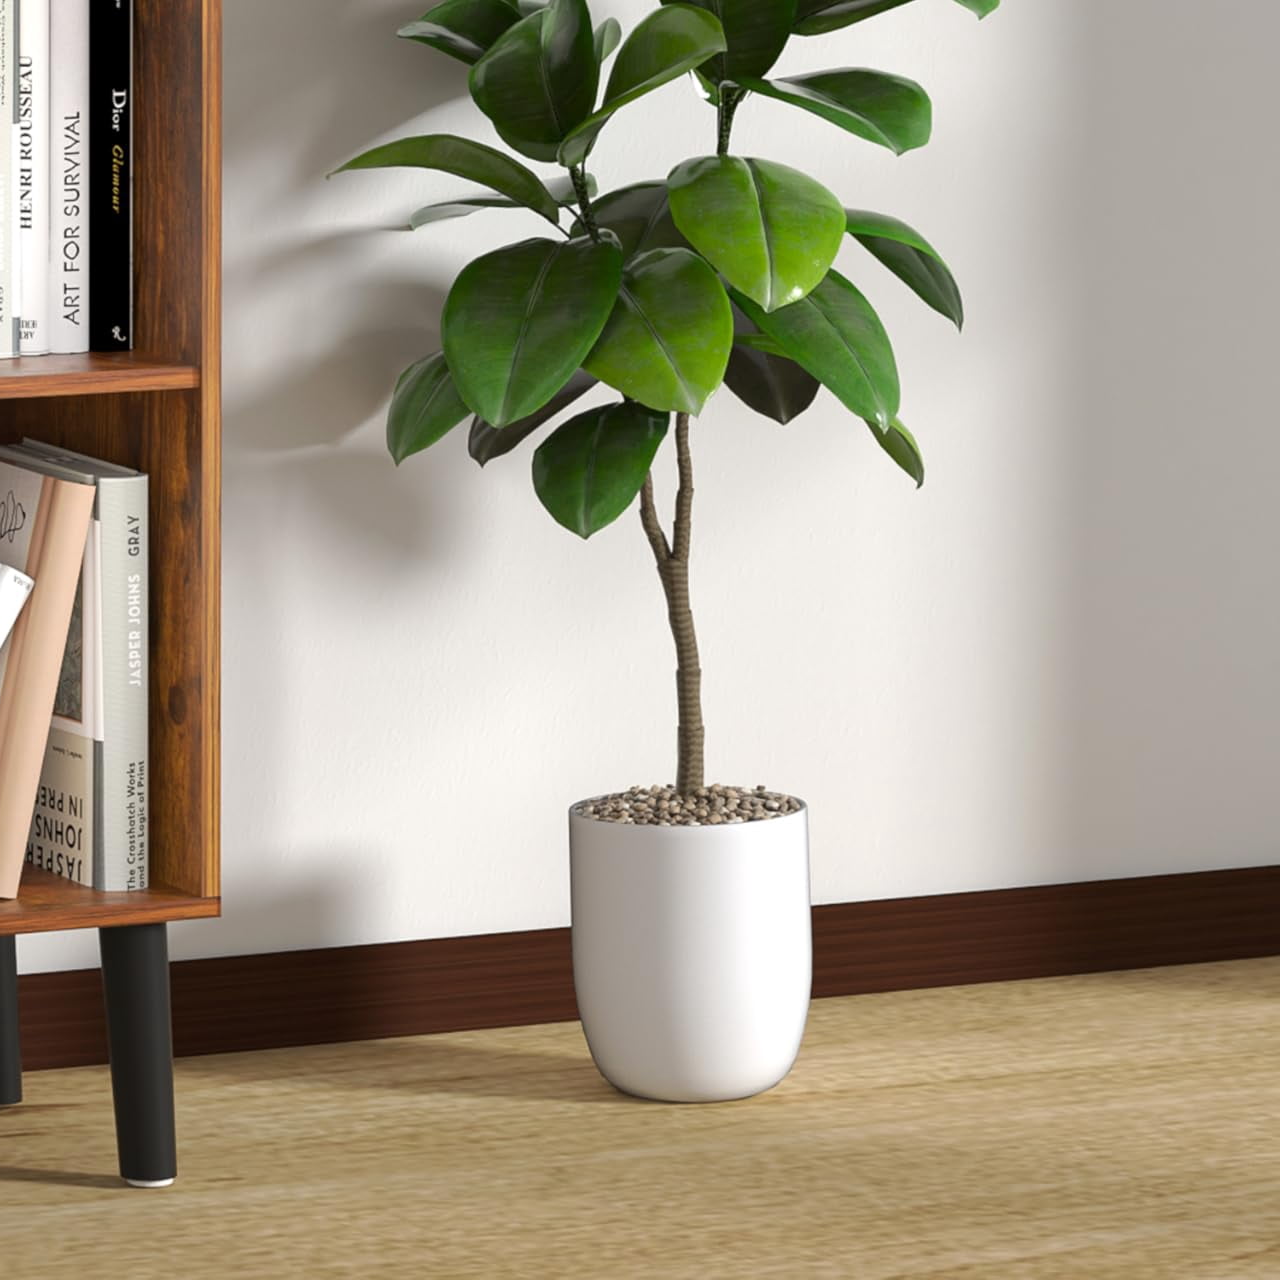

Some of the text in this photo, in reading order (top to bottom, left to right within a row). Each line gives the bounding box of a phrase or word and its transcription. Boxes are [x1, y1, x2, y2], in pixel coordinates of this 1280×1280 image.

[19, 55, 32, 230] HENRI ROUSSEAU
[111, 88, 127, 214] Dior Glamour
[64, 111, 81, 326] ART FOR SURVIVAL
[128, 515, 141, 686] JASPER JOHNS GRAY
[35, 814, 83, 851] JOHNS
[36, 786, 83, 819] IN PRE
[126, 762, 136, 892] The Crosshatch Works
[137, 761, 147, 889] and the Logic of Print
